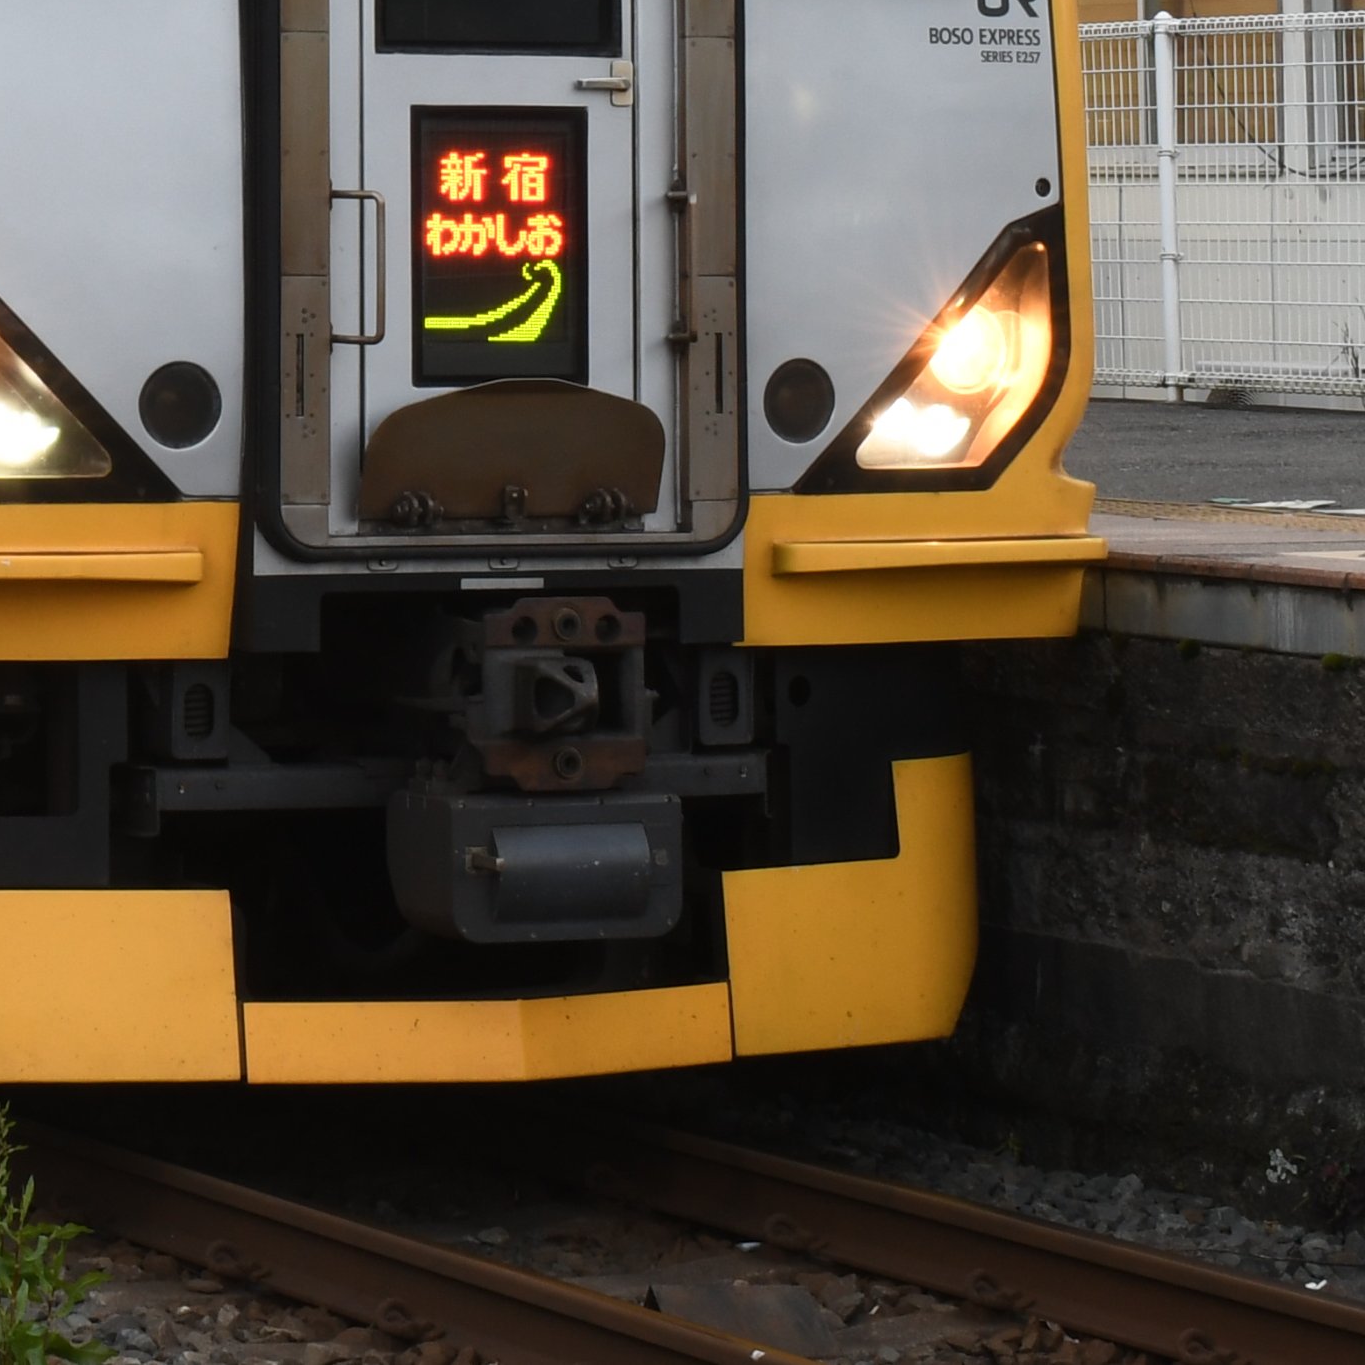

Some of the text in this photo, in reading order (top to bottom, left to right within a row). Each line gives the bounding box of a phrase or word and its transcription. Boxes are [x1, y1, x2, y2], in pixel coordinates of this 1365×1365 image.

[929, 27, 1041, 46] BOSO EXPRESS
[981, 50, 1041, 64] SERIES E257
[440, 152, 549, 201] 新宿
[426, 214, 563, 256] わかしお
